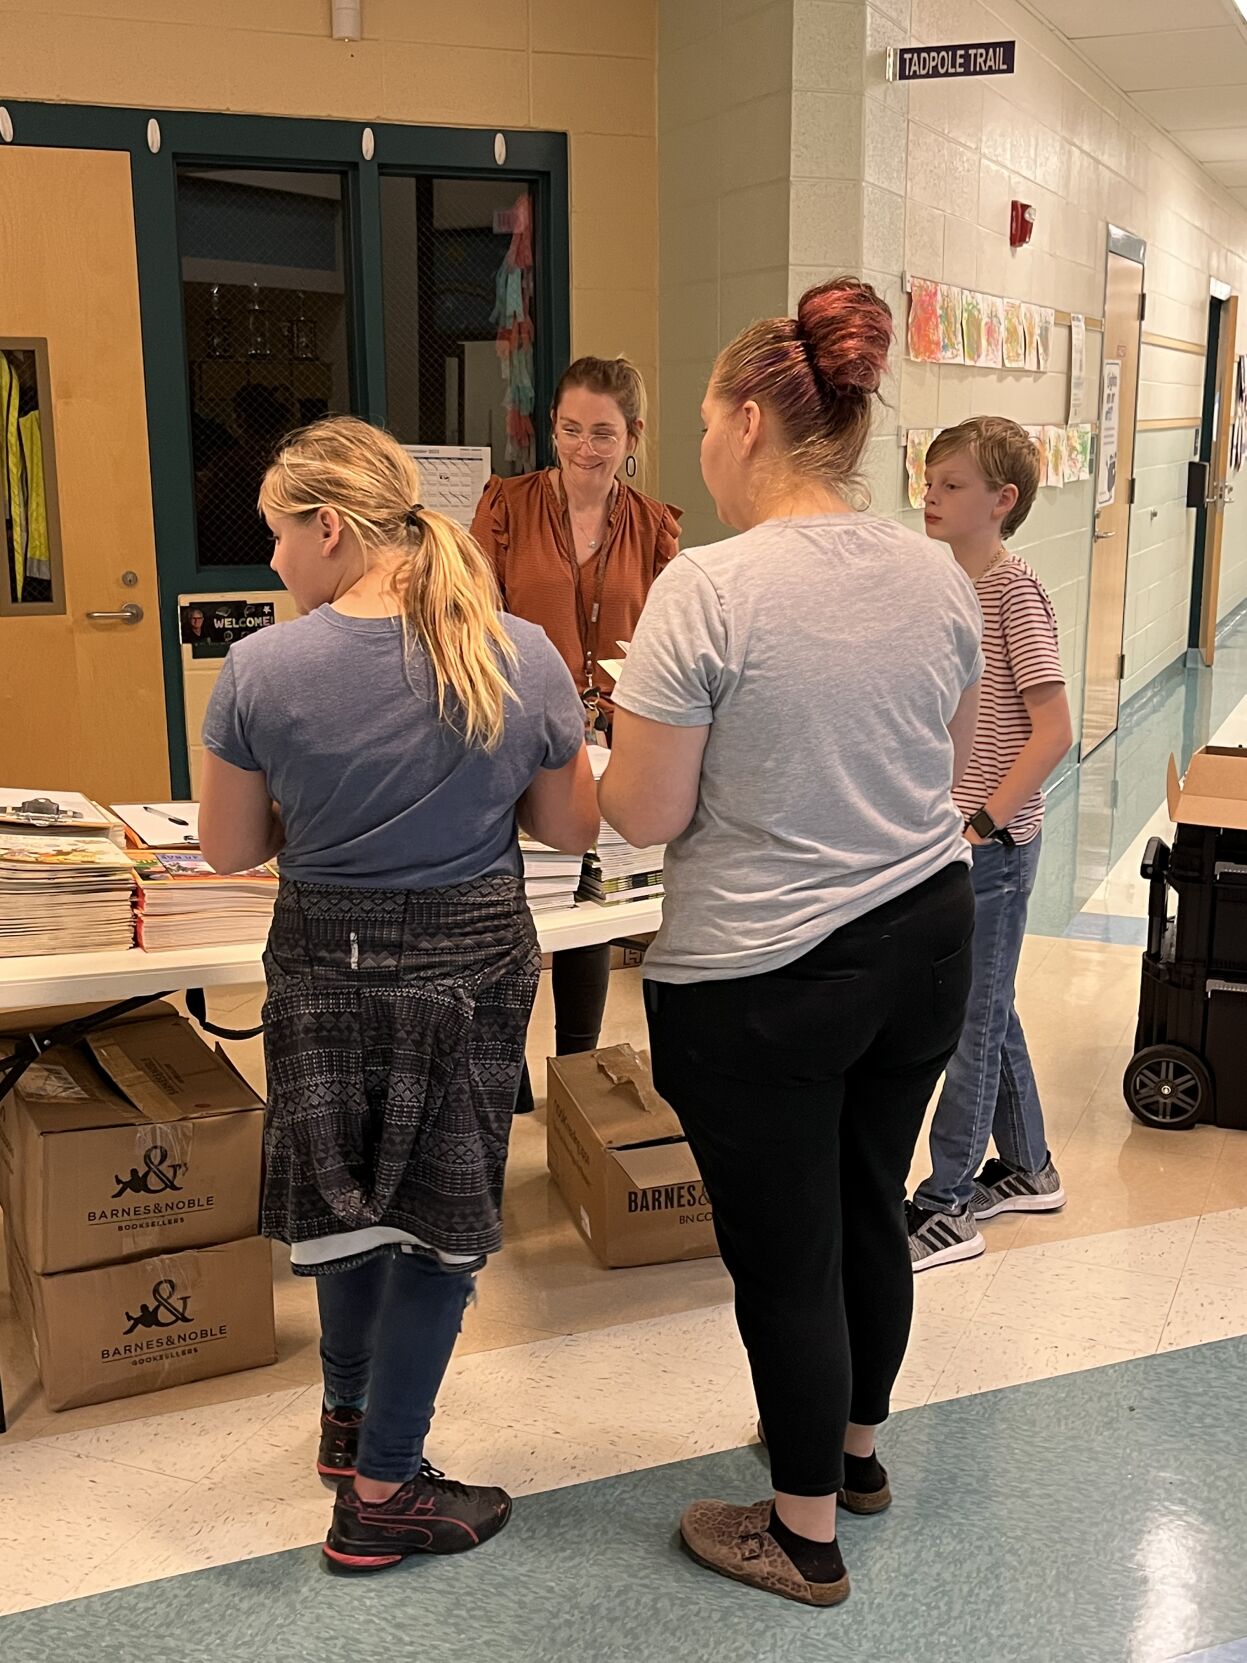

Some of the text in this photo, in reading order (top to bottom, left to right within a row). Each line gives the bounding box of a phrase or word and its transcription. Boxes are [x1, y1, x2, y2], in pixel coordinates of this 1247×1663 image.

[904, 47, 1008, 76] TADPOLE TRAIL
[87, 1196, 215, 1222] BARNES&NOBLE
[679, 1215, 694, 1225] BN
[117, 1217, 185, 1232] BOOKSELLERS
[100, 1324, 228, 1360] BARNES&NOBLE
